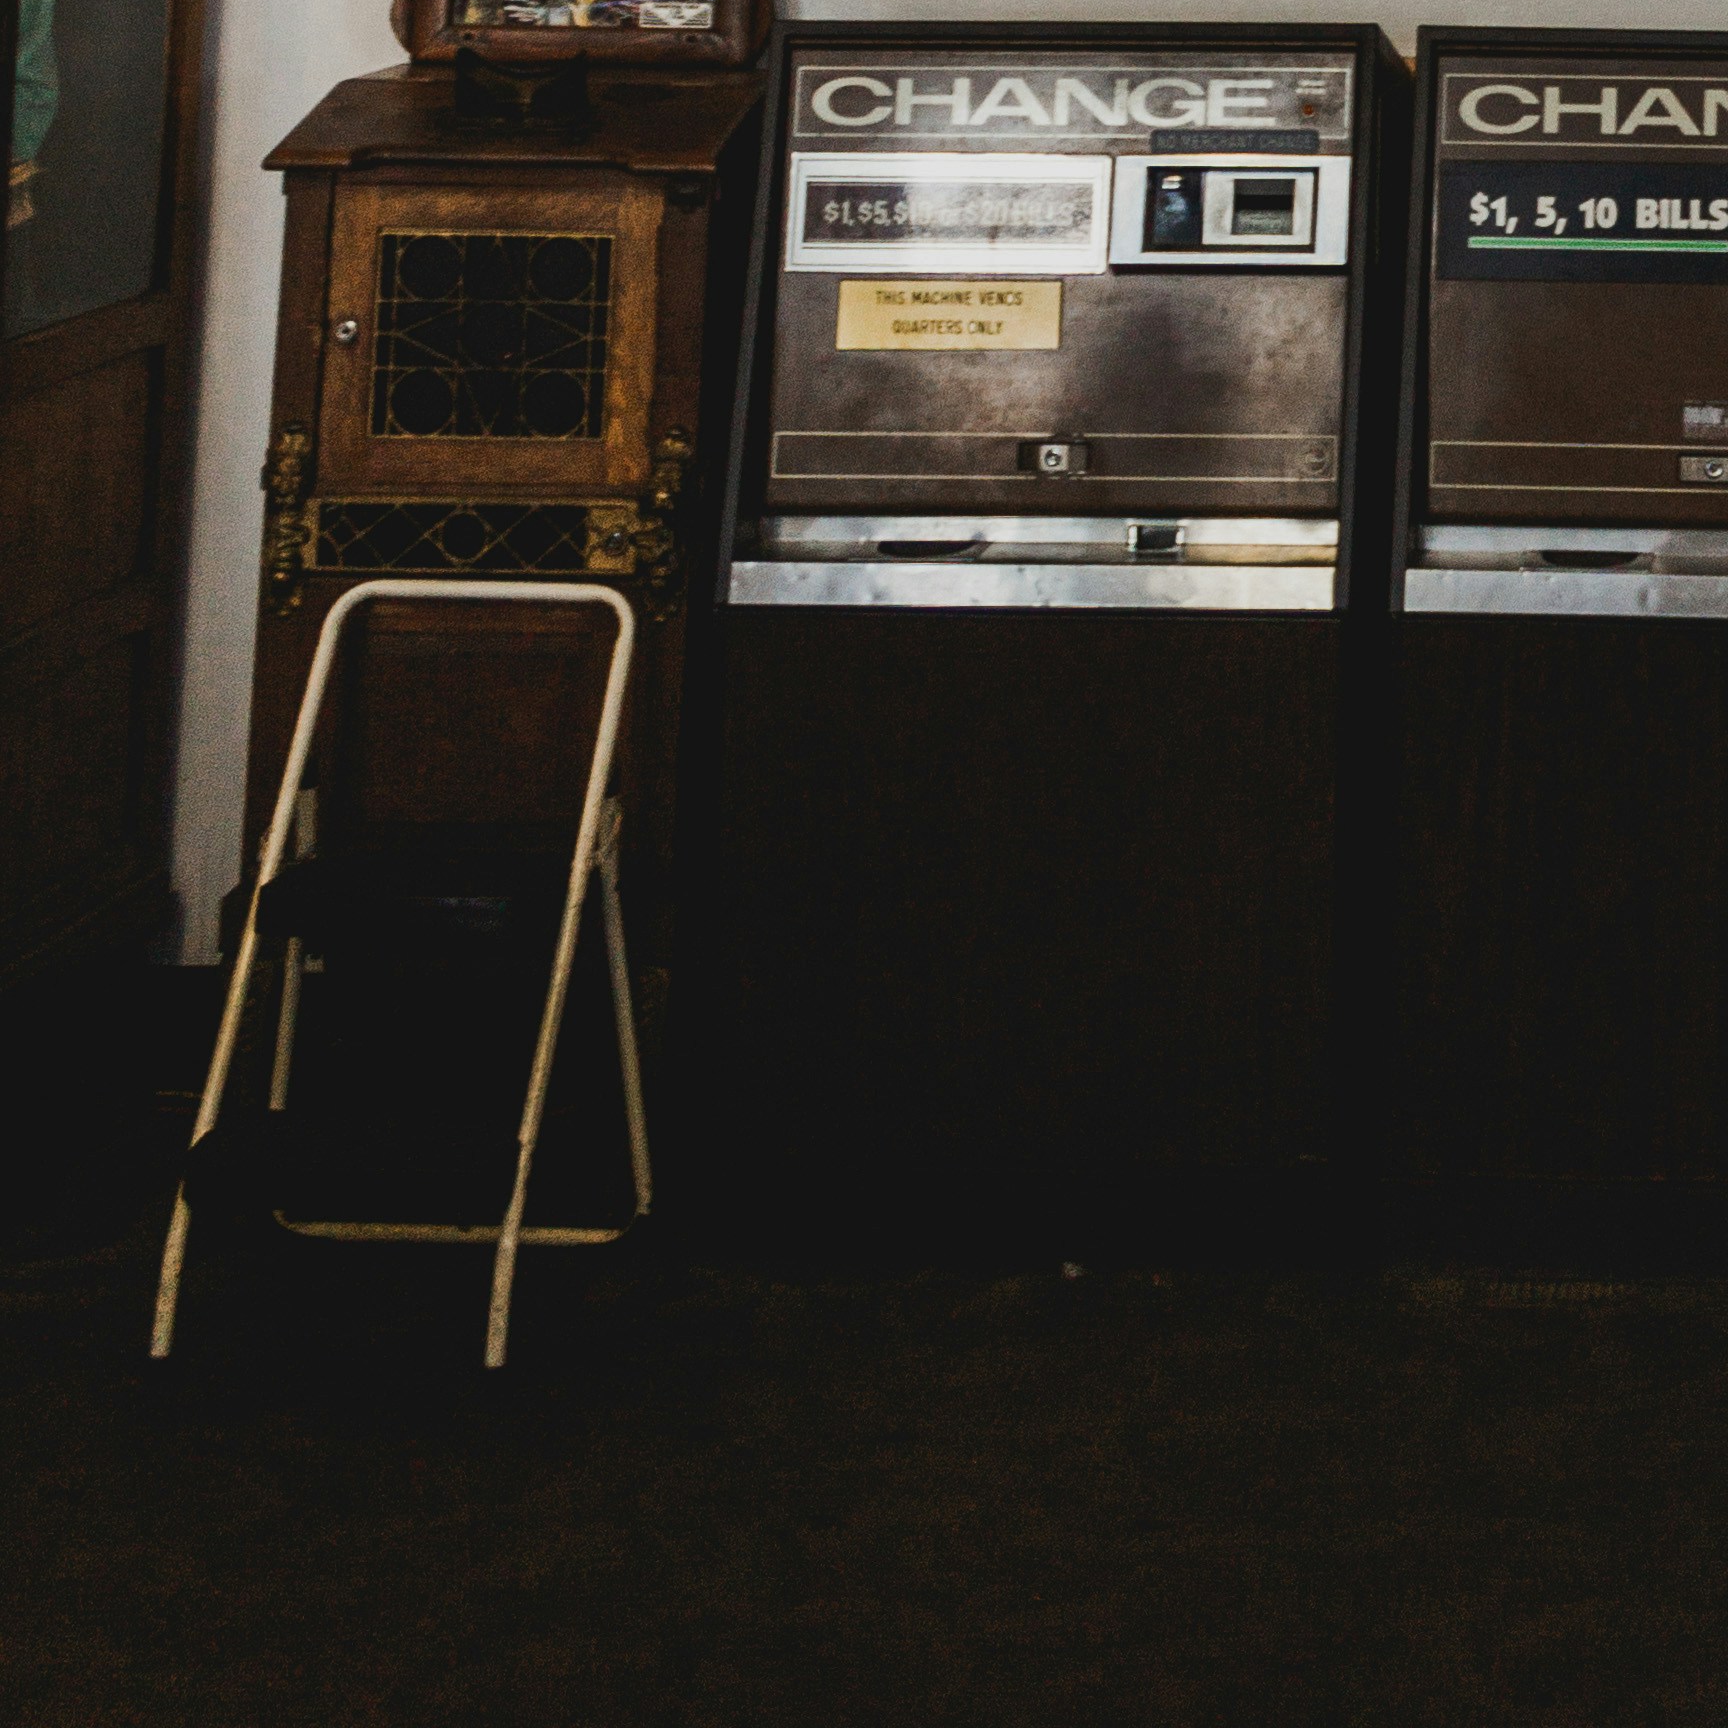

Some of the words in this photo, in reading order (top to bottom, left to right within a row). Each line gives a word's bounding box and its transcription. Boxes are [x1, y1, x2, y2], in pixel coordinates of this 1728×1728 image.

[810, 75, 1278, 129] CHANGE
[1467, 191, 1519, 235] $1,
[1535, 195, 1570, 236] 5,
[1578, 196, 1619, 230] 10
[876, 289, 905, 306] THIS
[911, 289, 973, 306] MACHINE
[892, 319, 963, 335] QUARTERS
[967, 319, 1004, 336] ONLY
